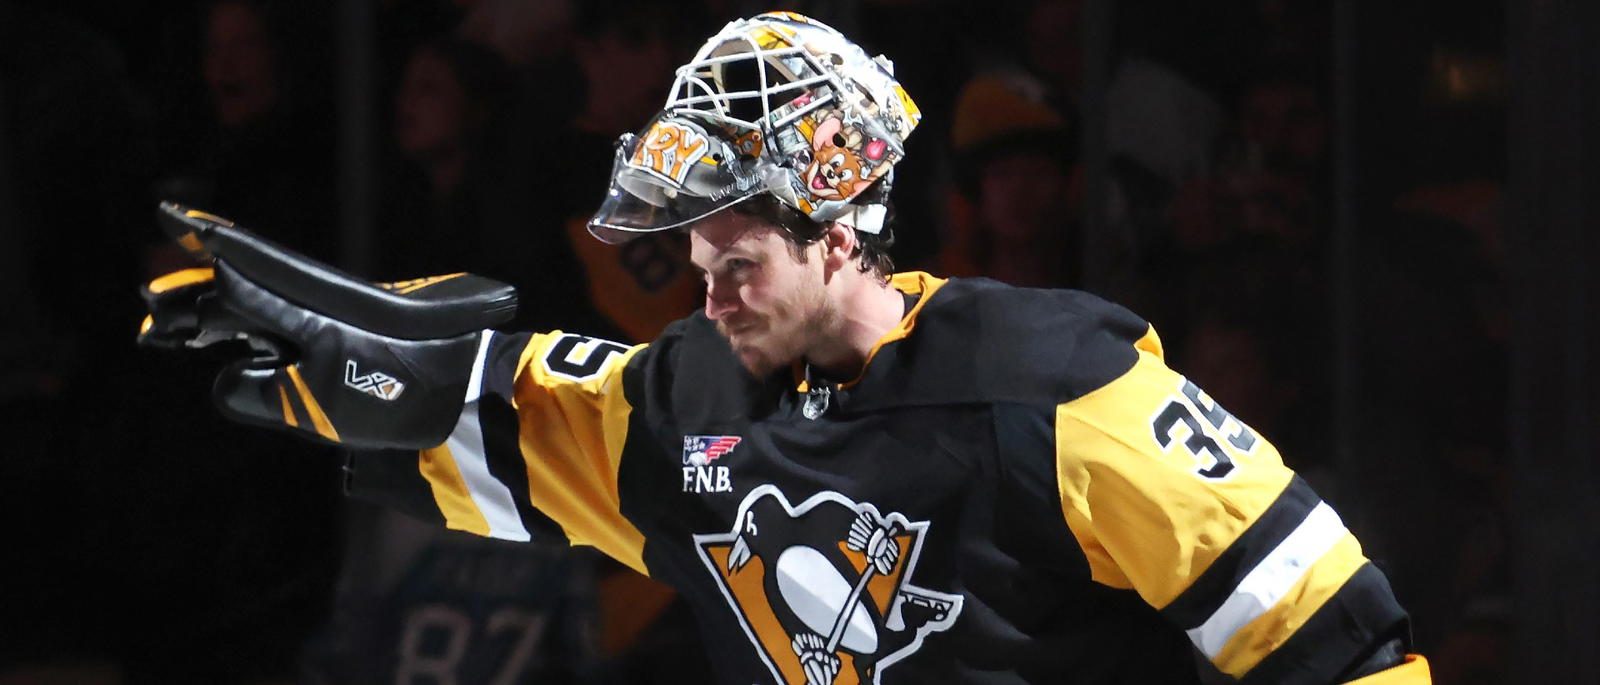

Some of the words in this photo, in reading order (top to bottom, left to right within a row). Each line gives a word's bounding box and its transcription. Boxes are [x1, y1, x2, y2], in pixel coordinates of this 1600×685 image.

[1151, 378, 1258, 480] 35
[682, 465, 733, 494] F.N.B.
[397, 604, 549, 685] 87
